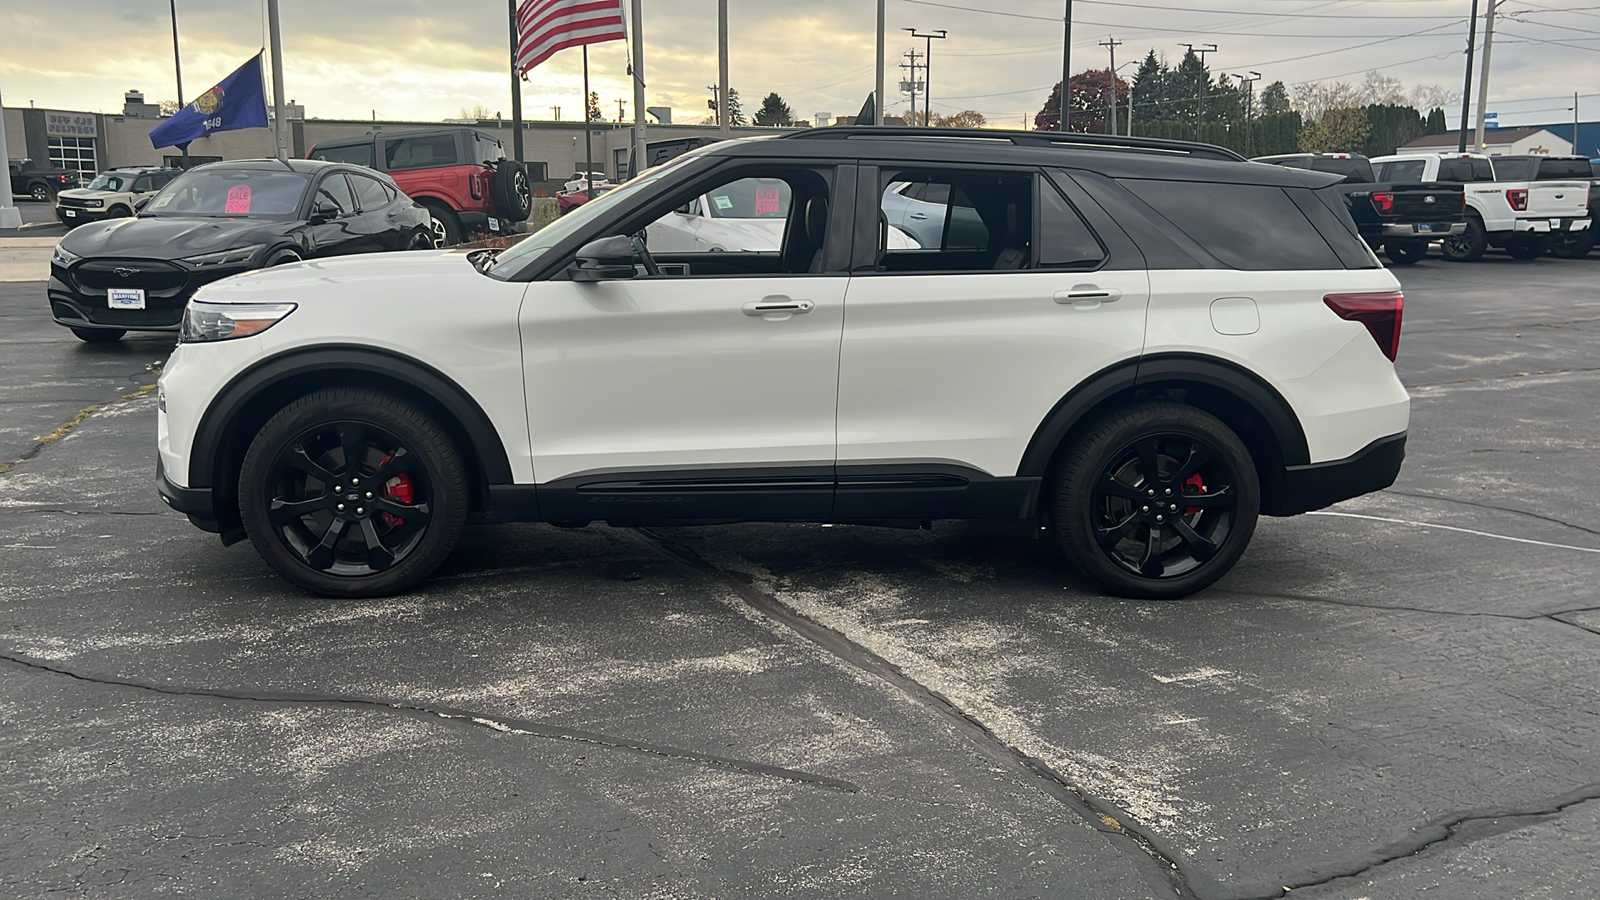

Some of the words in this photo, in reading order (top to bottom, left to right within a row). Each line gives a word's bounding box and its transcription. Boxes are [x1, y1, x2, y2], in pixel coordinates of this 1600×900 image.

[50, 115, 71, 124] NEW
[203, 116, 222, 130] 1848
[48, 123, 95, 134] DELIVERY
[229, 191, 249, 200] SALE
[758, 190, 776, 199] SALE
[113, 292, 140, 301] MARITIME
